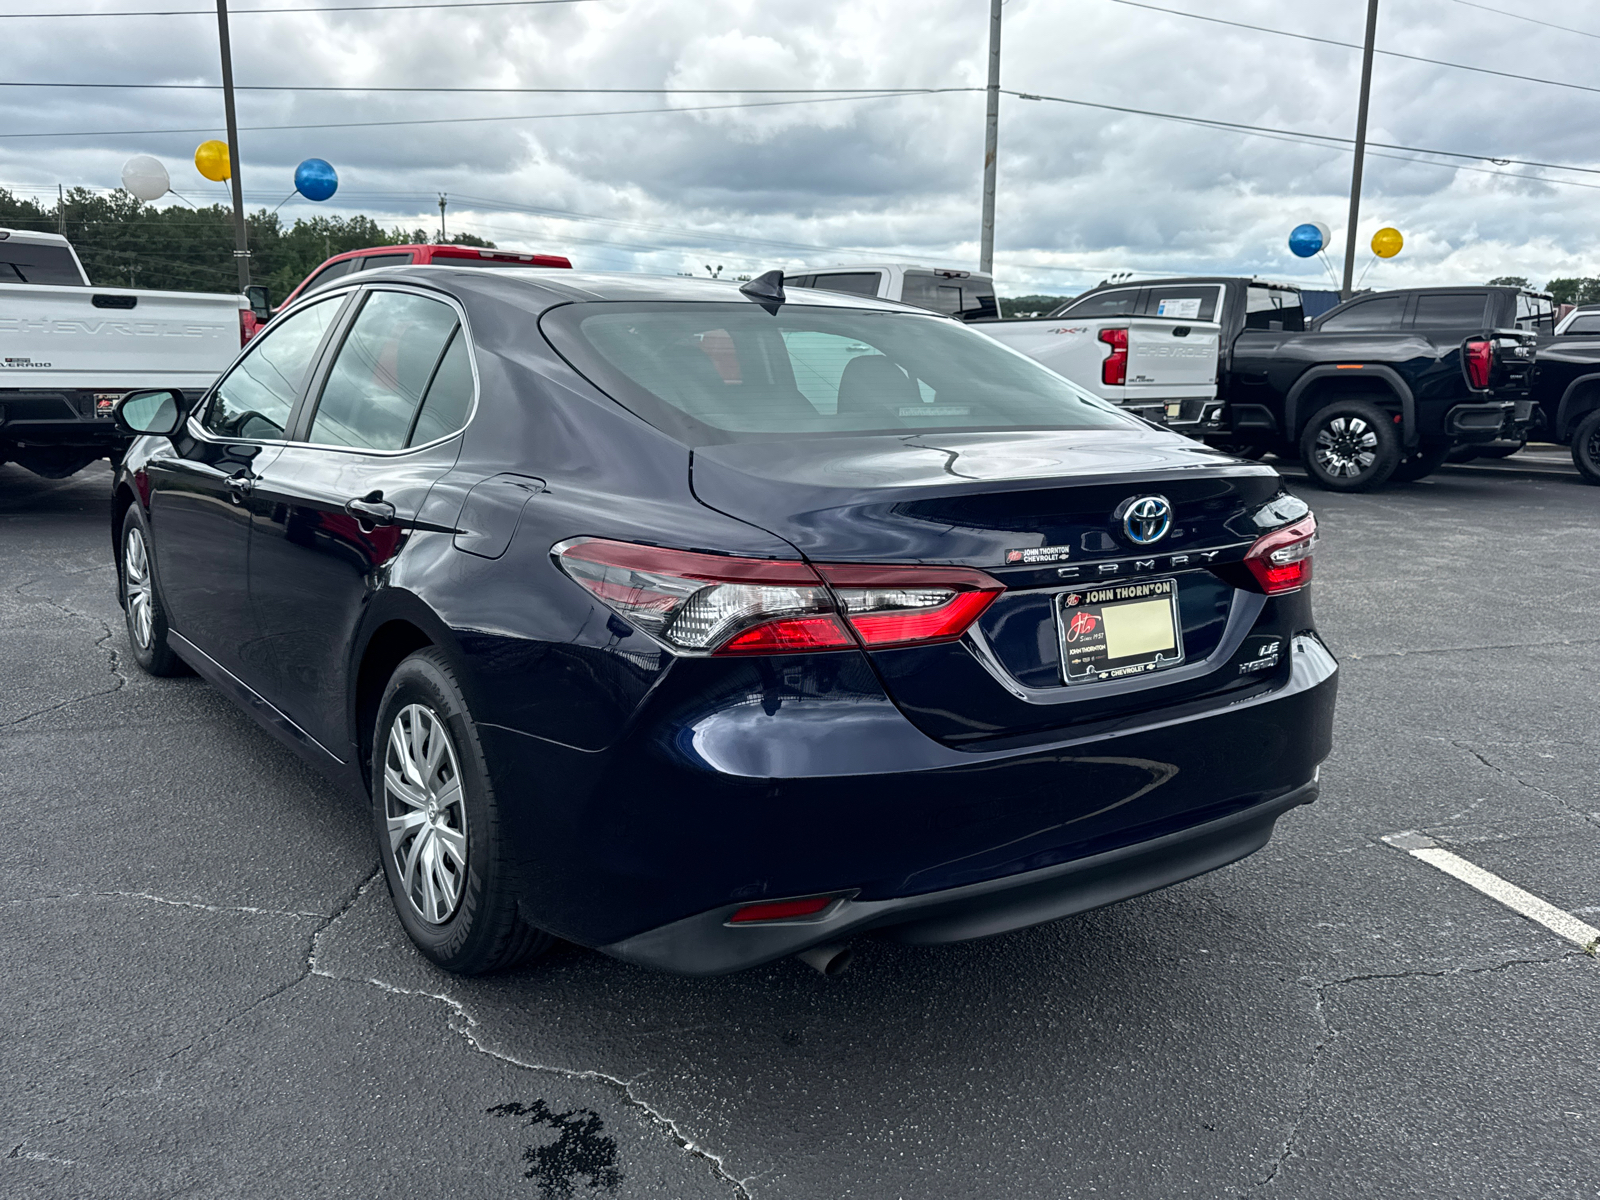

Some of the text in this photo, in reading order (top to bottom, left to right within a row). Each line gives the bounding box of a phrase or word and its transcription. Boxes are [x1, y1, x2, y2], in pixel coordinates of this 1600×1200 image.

[1136, 346, 1215, 358] CHEVROLET
[1023, 545, 1070, 557] JOHN THORNTON
[1023, 554, 1059, 563] CHEVROLET
[1058, 550, 1219, 578] CAMRY
[1086, 589, 1114, 603] JOHN
[1069, 648, 1082, 656] JOHN
[1110, 665, 1145, 678] CHEVROLET
